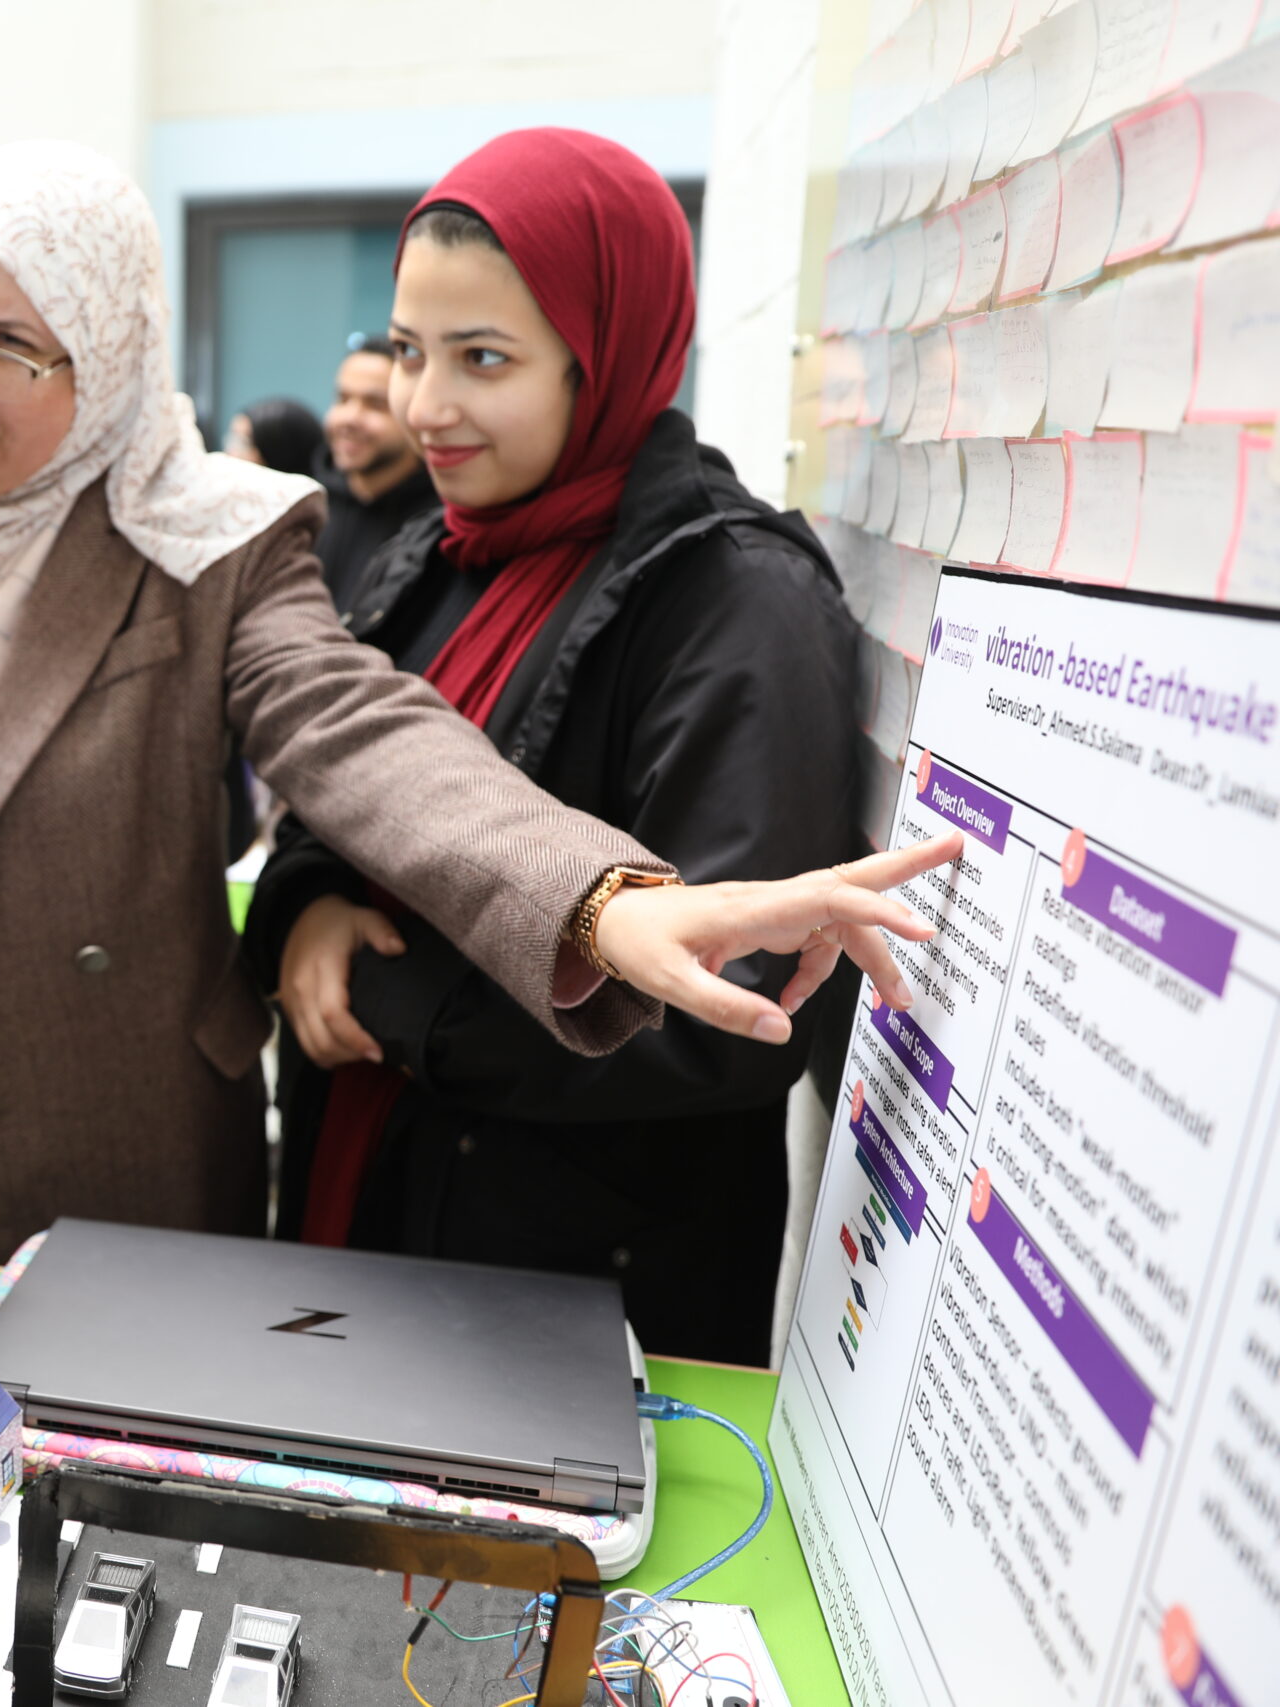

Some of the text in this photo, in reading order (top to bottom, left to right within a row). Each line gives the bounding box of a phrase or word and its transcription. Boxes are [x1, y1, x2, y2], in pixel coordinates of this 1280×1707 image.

[940, 643, 974, 673] University
[985, 626, 1277, 744] vibration -based Earthquake
[900, 813, 906, 827] A
[904, 819, 922, 840] smart
[931, 781, 995, 837] Project Overview
[928, 868, 1004, 942] vibrations and provides
[957, 852, 982, 885] detects
[918, 894, 935, 921] alerts
[964, 936, 991, 971] people
[991, 961, 1008, 985] and
[1031, 934, 1078, 984] readings
[1094, 925, 1153, 982] vibration
[896, 945, 956, 1016] and stopping devices
[950, 963, 979, 1004] warning
[886, 1008, 934, 1076] Aim and Scope
[1013, 1014, 1046, 1057] values
[1022, 969, 1082, 1036] Predefined
[1081, 1021, 1138, 1085] vibration
[862, 1028, 878, 1053] detect
[877, 1048, 911, 1099] earthquakes
[910, 1091, 928, 1129] using
[927, 1109, 958, 1164] vibration
[995, 1095, 1016, 1126] and
[1004, 1049, 1047, 1108] Includes
[1045, 1089, 1074, 1136] both
[862, 1109, 882, 1149] System
[879, 1137, 914, 1201] Architecture
[868, 1070, 879, 1096] and
[878, 1082, 898, 1120] trigger
[896, 1105, 917, 1145] instant
[916, 1140, 936, 1179] safety
[935, 1164, 956, 1204] alerts
[986, 1127, 996, 1155] is
[995, 1142, 1030, 1194] critical
[1029, 1177, 1046, 1212] for
[948, 1240, 988, 1314] Vibration
[987, 1301, 1021, 1362] Sensor
[1012, 1236, 1066, 1320] Methods
[923, 1352, 954, 1414] devices
[952, 1407, 971, 1445] and
[906, 1423, 955, 1529] sound alarm
[915, 1384, 934, 1430] LEDs
[942, 1432, 967, 1496] Traffic
[966, 1485, 991, 1543] Light
[802, 1509, 815, 1555] Farah
